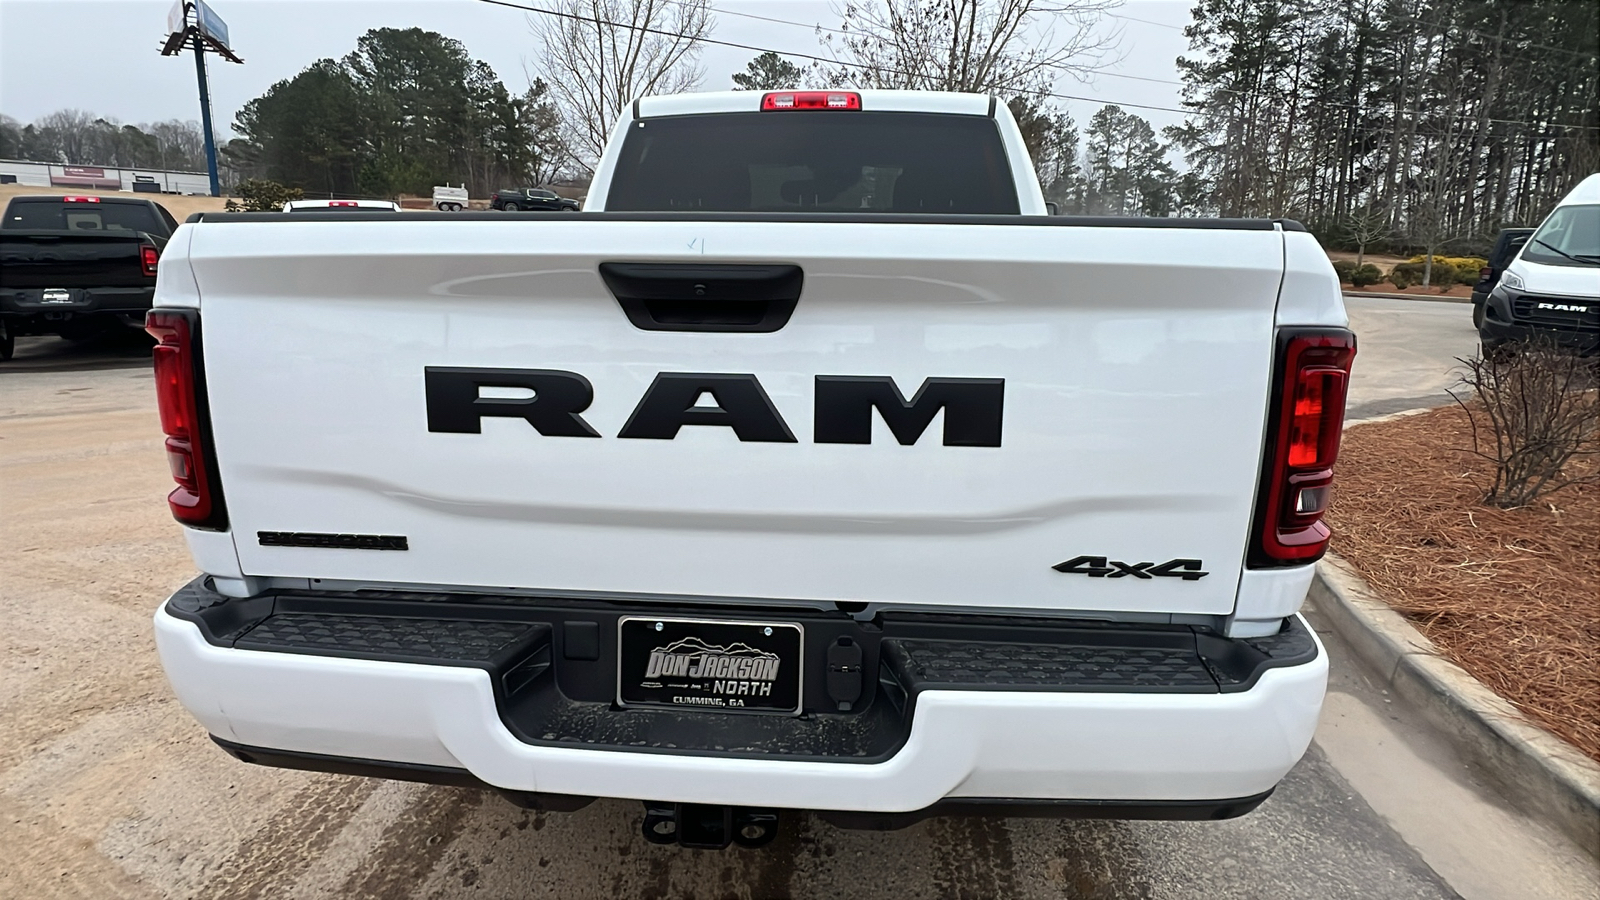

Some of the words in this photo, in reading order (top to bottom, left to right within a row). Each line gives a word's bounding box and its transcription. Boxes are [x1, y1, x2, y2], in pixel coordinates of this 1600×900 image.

[1538, 303, 1587, 312] RAM
[425, 366, 1005, 447] RAM
[690, 654, 780, 681] JACKSON
[713, 680, 772, 696] NORTH
[673, 696, 726, 707] CUMMING,
[729, 699, 745, 707] GA
